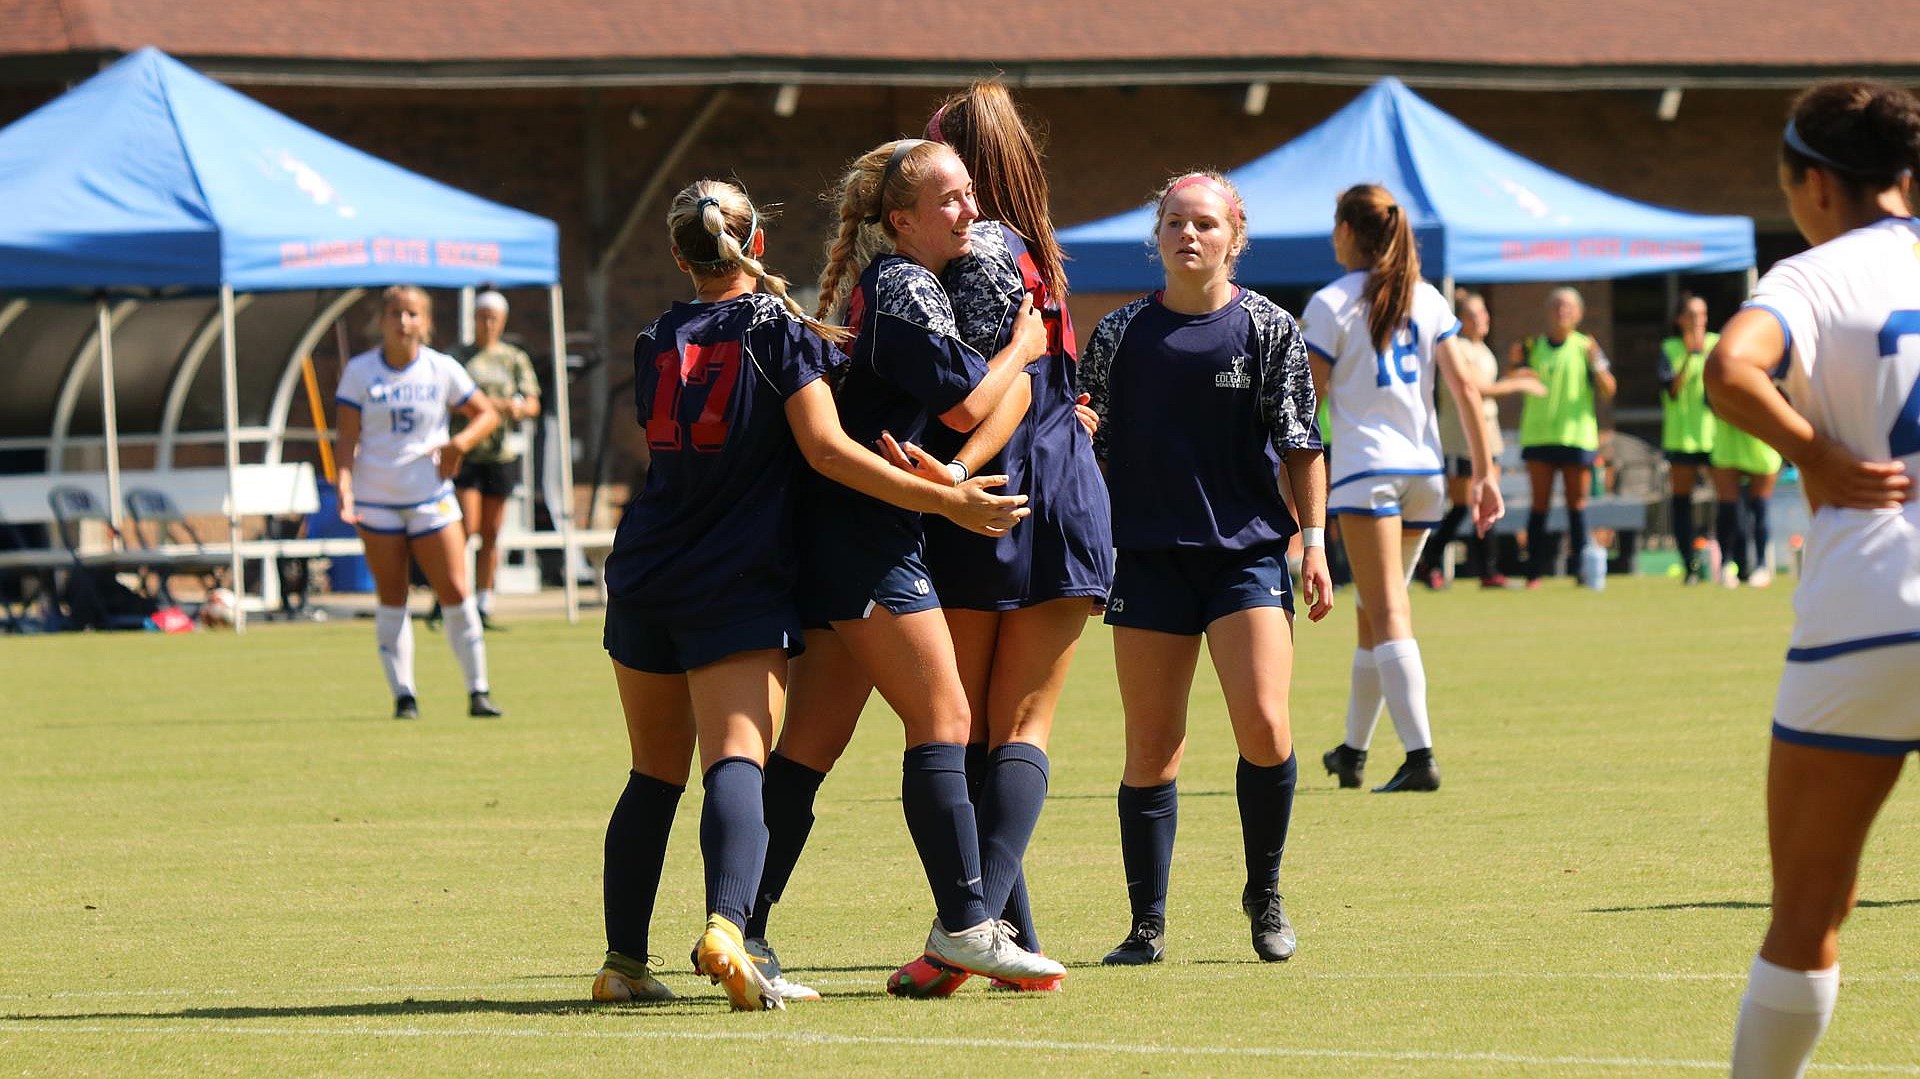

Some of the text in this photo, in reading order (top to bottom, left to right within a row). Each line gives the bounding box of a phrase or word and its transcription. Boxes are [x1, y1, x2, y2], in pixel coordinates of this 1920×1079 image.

[646, 340, 741, 453] 17
[390, 407, 415, 433] 15
[914, 578, 930, 595] 18
[1111, 597, 1124, 613] 23
